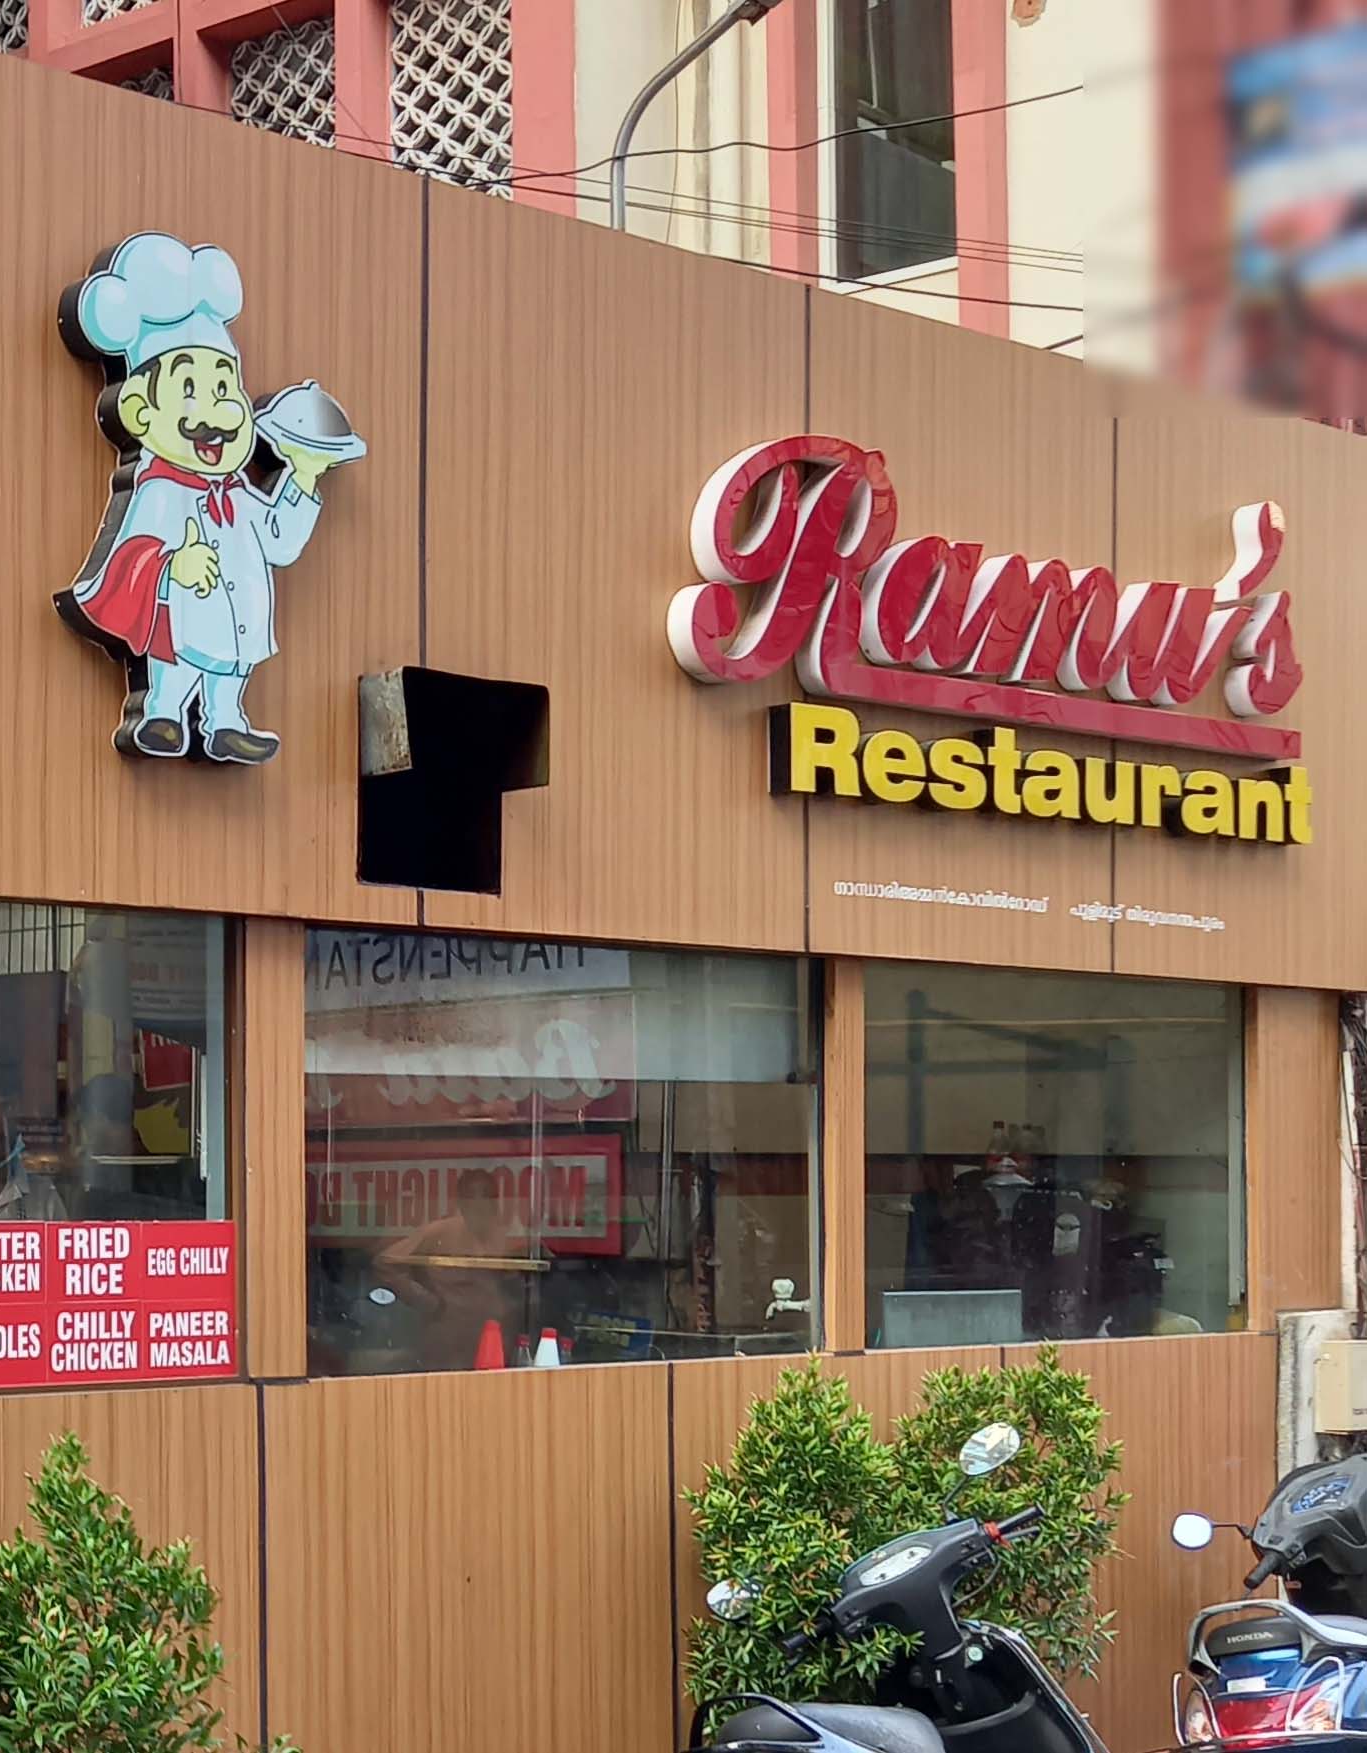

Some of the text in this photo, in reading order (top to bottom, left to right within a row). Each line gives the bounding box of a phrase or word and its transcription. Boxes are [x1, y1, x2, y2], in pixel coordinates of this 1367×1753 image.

[666, 434, 1303, 716] Ramu's
[790, 702, 1313, 845] Restaurant
[58, 1227, 130, 1260] FRIED
[148, 1247, 229, 1276] EGG CHILLY
[66, 1263, 123, 1295] RICE
[57, 1311, 135, 1341] CHILLY
[150, 1311, 229, 1338] PANEER
[51, 1342, 138, 1373] CHICKEN
[150, 1340, 231, 1368] MASALA
[1226, 1631, 1274, 1644] HONDA
